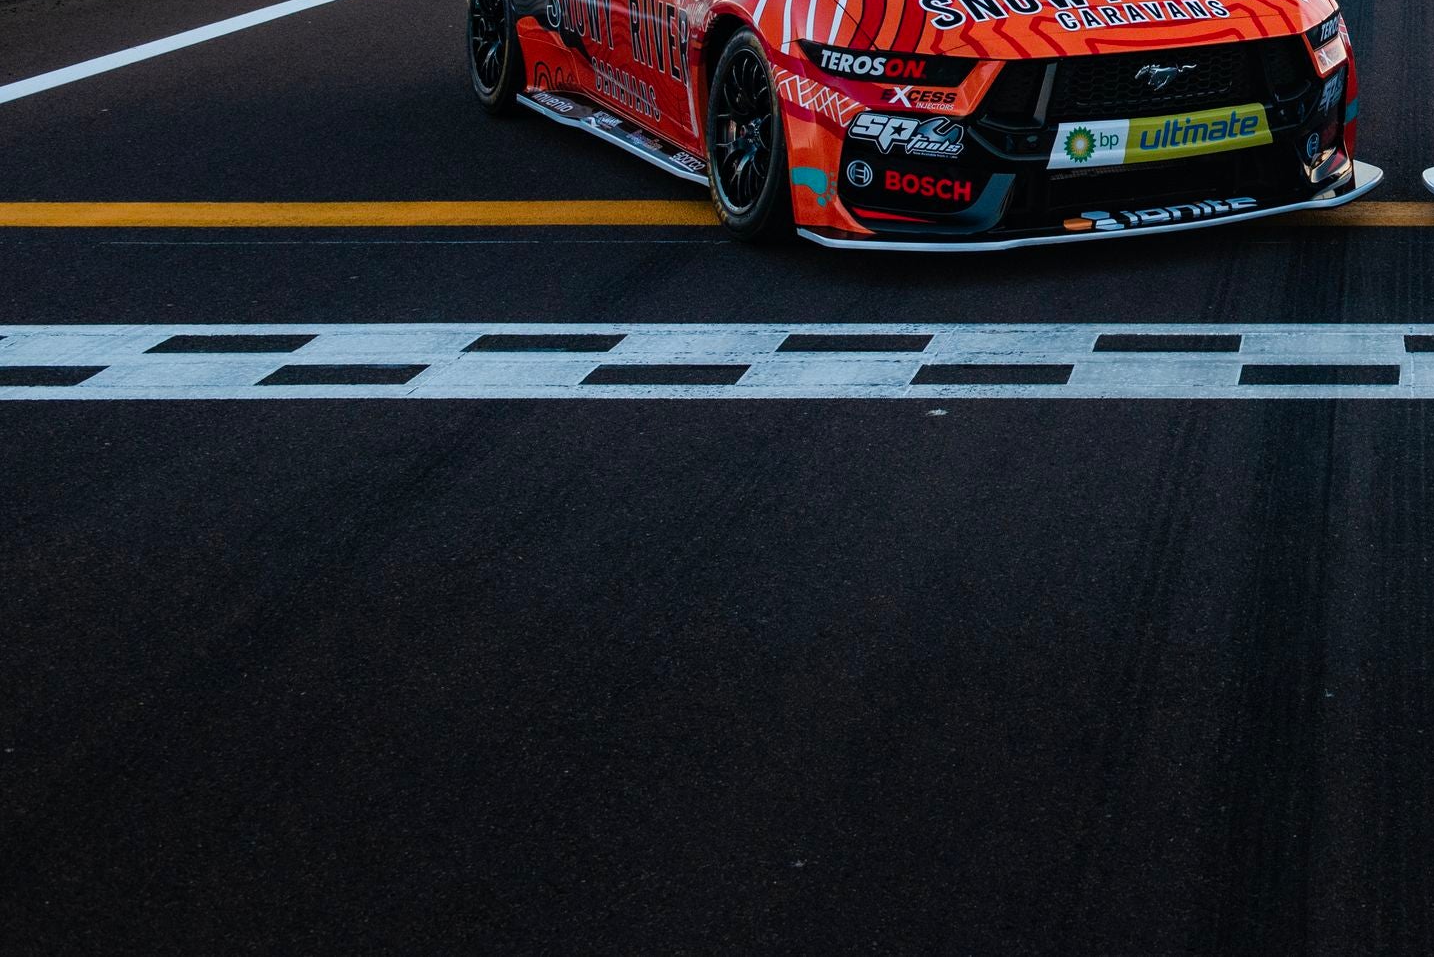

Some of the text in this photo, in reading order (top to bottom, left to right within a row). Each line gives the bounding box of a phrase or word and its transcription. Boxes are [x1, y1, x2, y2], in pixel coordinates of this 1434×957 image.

[820, 49, 926, 80] TEROSON
[881, 85, 957, 108] EXCESS
[851, 114, 918, 151] SP
[1100, 111, 1259, 151] bp ultimate
[884, 170, 972, 202] BOSCH
